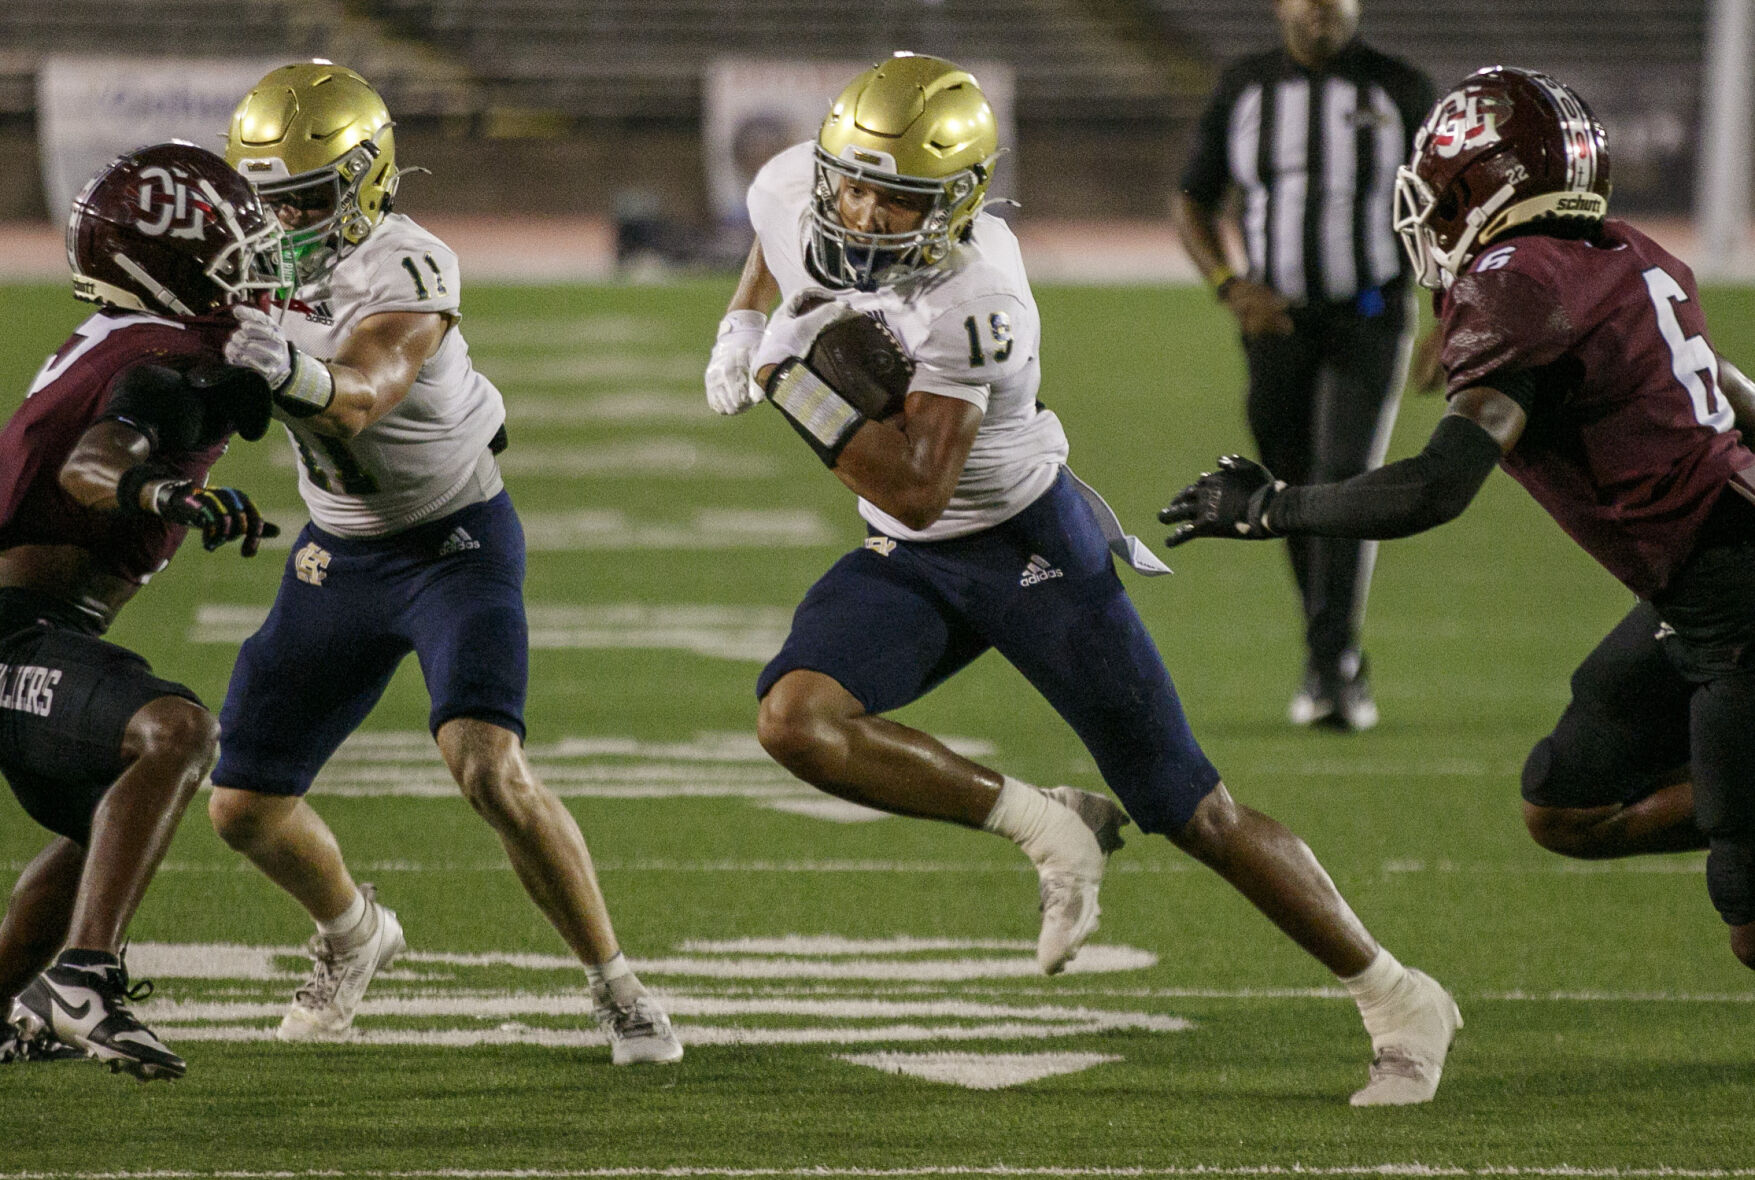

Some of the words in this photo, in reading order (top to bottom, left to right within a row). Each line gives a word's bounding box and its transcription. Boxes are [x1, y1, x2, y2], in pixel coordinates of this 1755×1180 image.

[1505, 165, 1530, 186] 22
[402, 250, 448, 301] 11
[1476, 246, 1517, 272] 6
[1641, 264, 1736, 433] 6
[1019, 568, 1063, 588] adidas
[0, 663, 63, 718] LIERS
